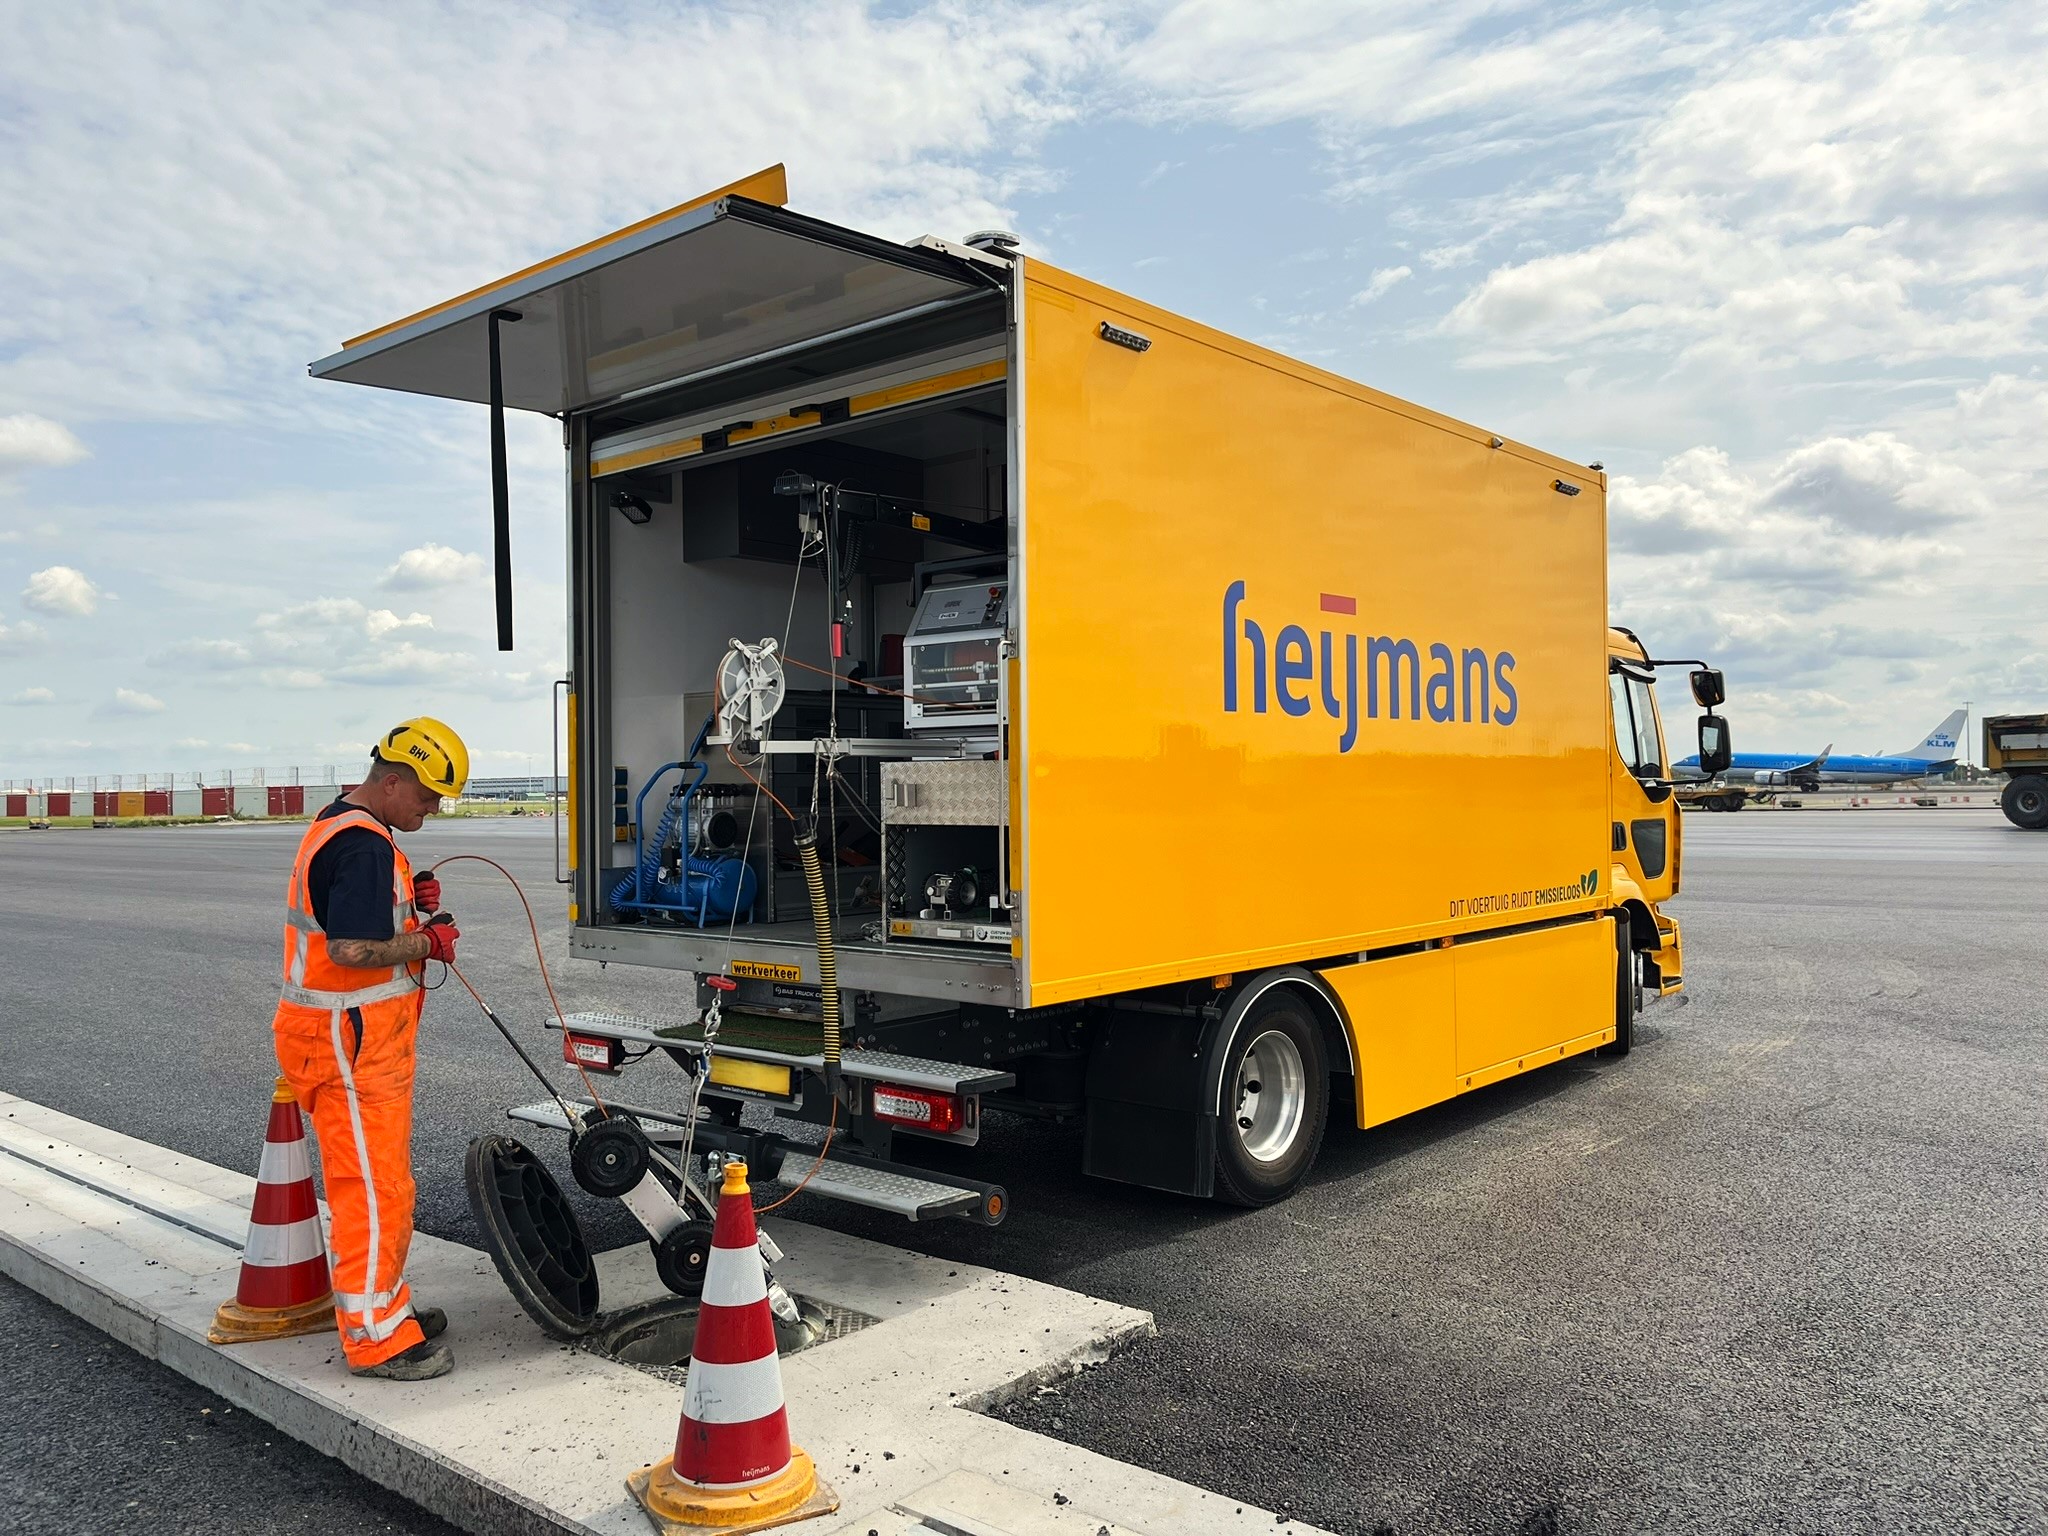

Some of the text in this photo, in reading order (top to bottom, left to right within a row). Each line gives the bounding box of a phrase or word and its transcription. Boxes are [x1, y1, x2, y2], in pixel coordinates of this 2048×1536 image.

[1223, 580, 1518, 753] heijmans
[1927, 740, 1956, 748] KLM
[409, 744, 431, 761] BHV
[1450, 884, 1581, 918] DIT VOERTUIG RIJDT EMISSIELOOS
[733, 963, 798, 979] werkverkeer
[742, 1465, 770, 1477] heijmans
